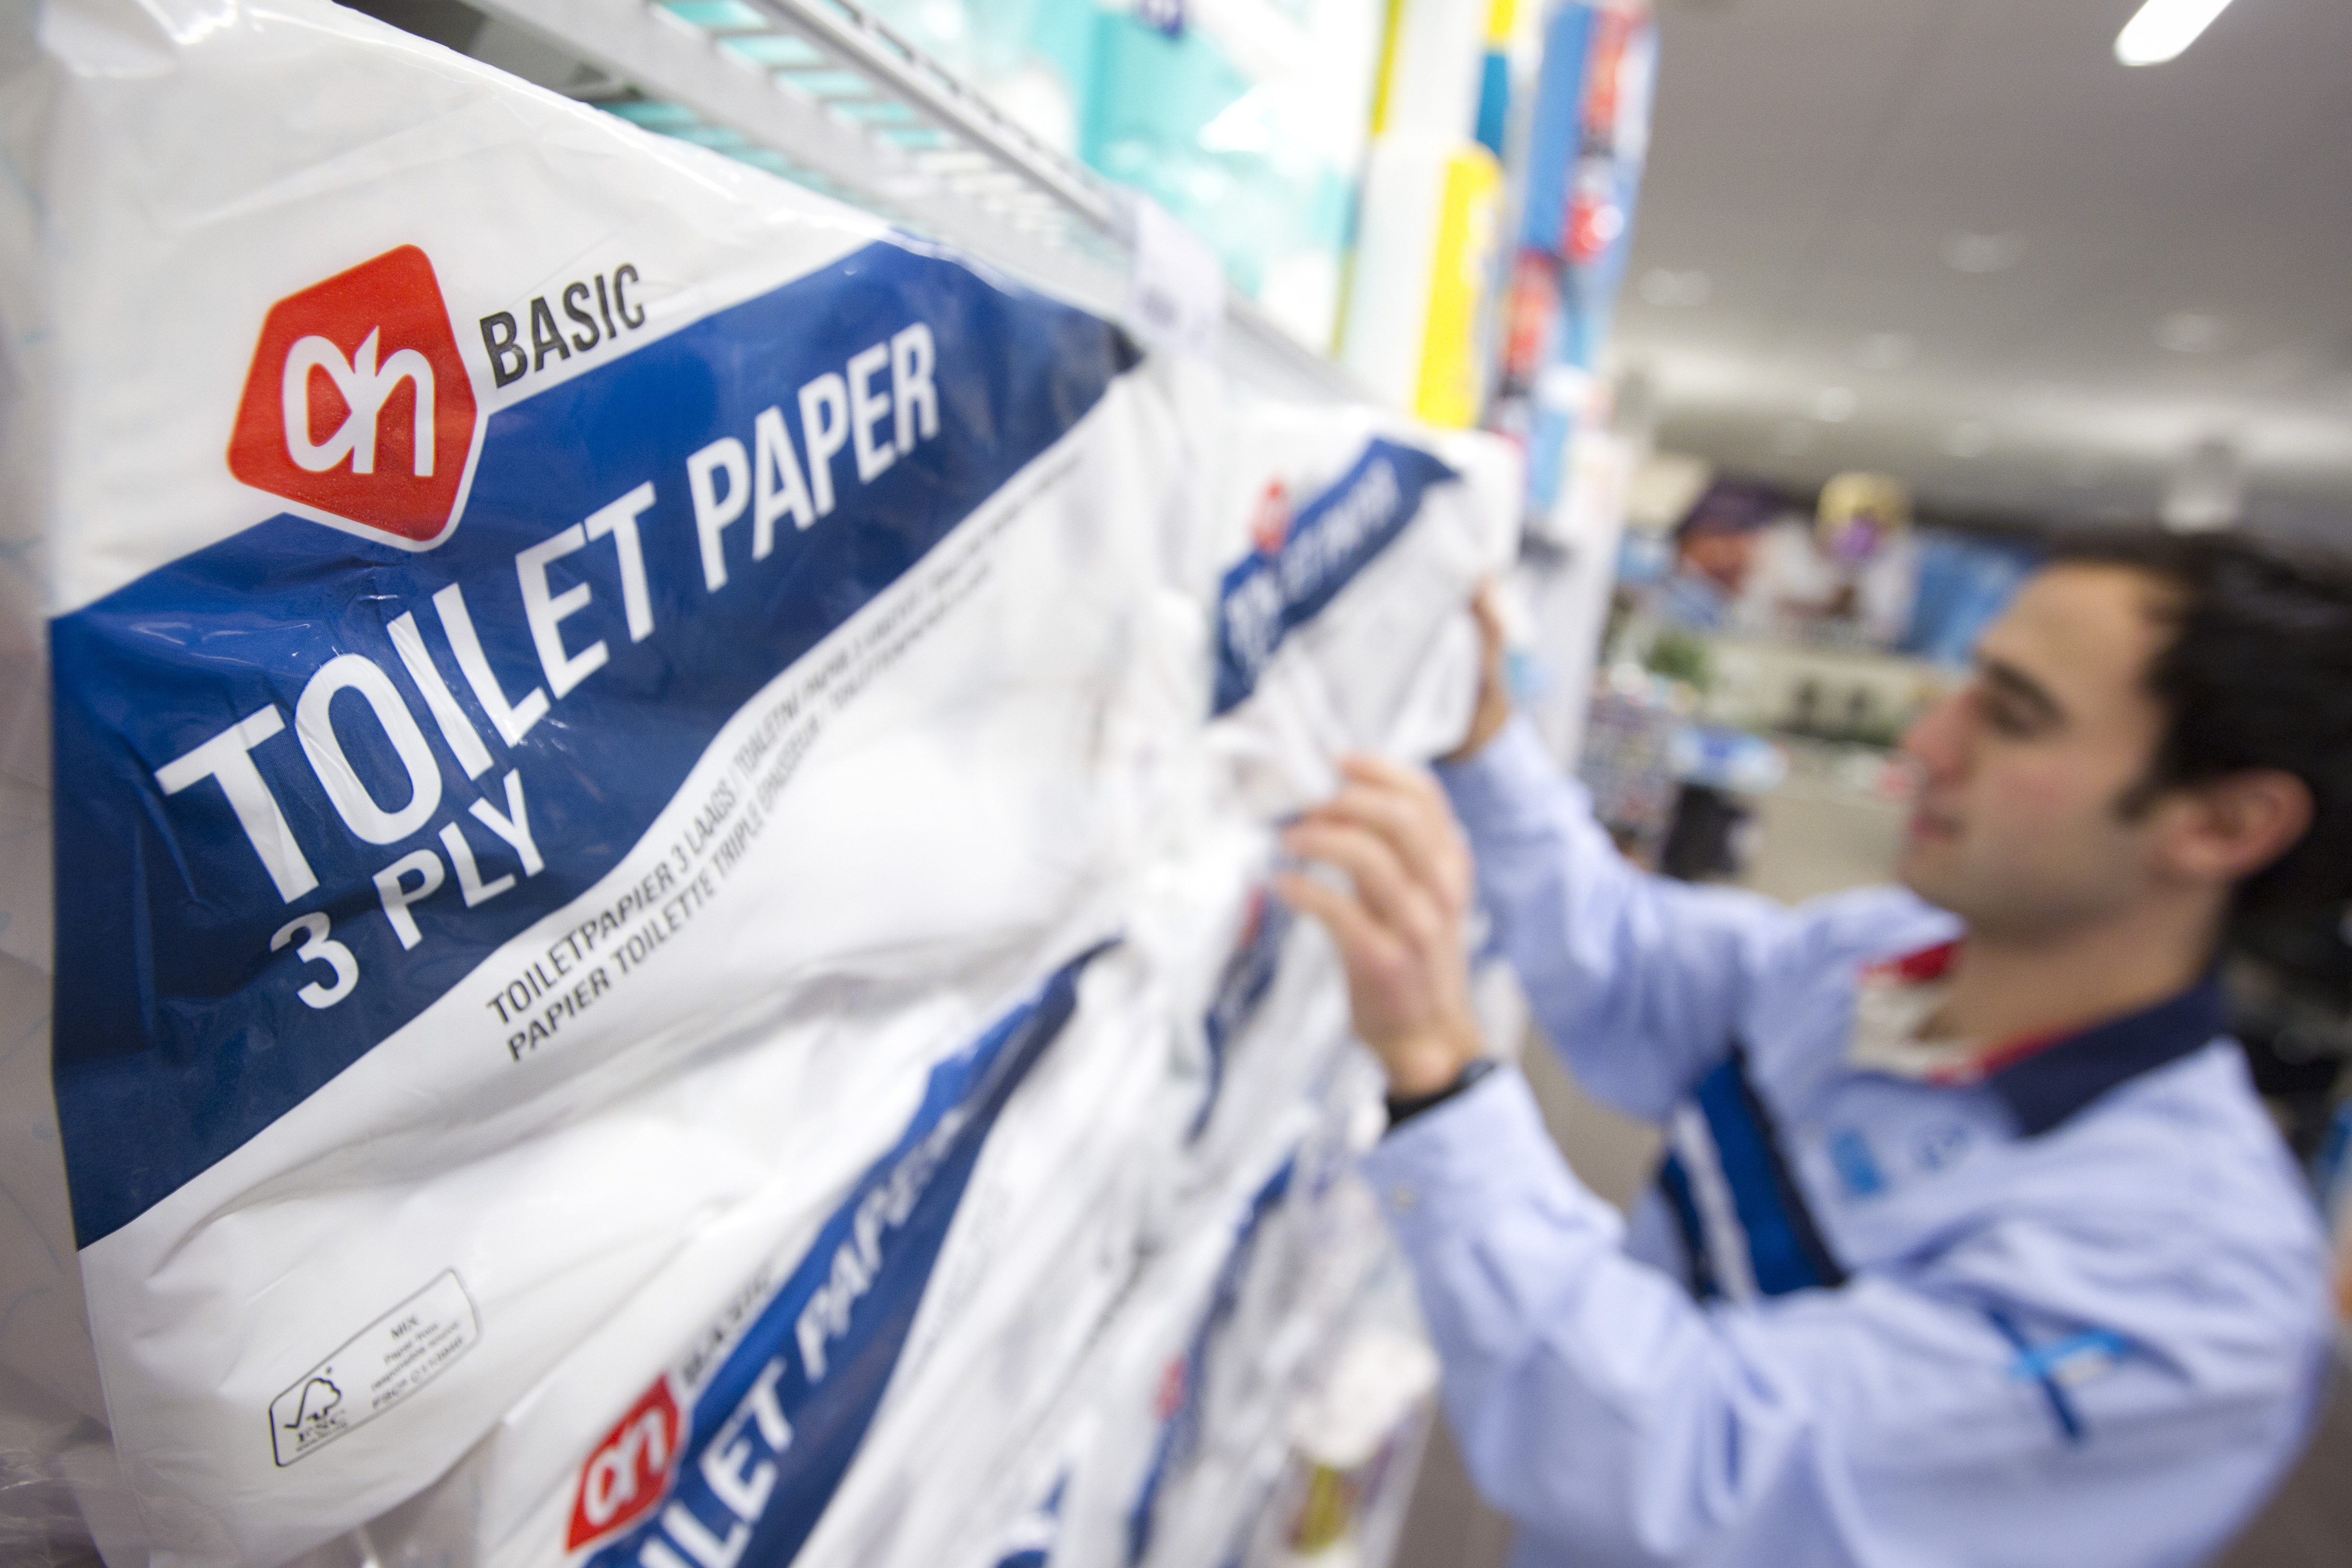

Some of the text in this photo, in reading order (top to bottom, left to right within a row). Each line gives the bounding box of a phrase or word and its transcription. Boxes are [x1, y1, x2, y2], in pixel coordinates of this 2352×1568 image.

[478, 262, 647, 390] BASIC
[153, 479, 657, 905] TOILET
[686, 321, 940, 593] PAPER
[270, 768, 545, 1010] 3 PLY
[486, 860, 674, 1027] TOILETPAPIER
[670, 842, 691, 875] 3
[683, 781, 737, 856] LAAGS
[505, 966, 612, 1063] PAPIER
[611, 873, 717, 976] TOILETTE
[708, 797, 765, 880] TRIPLE
